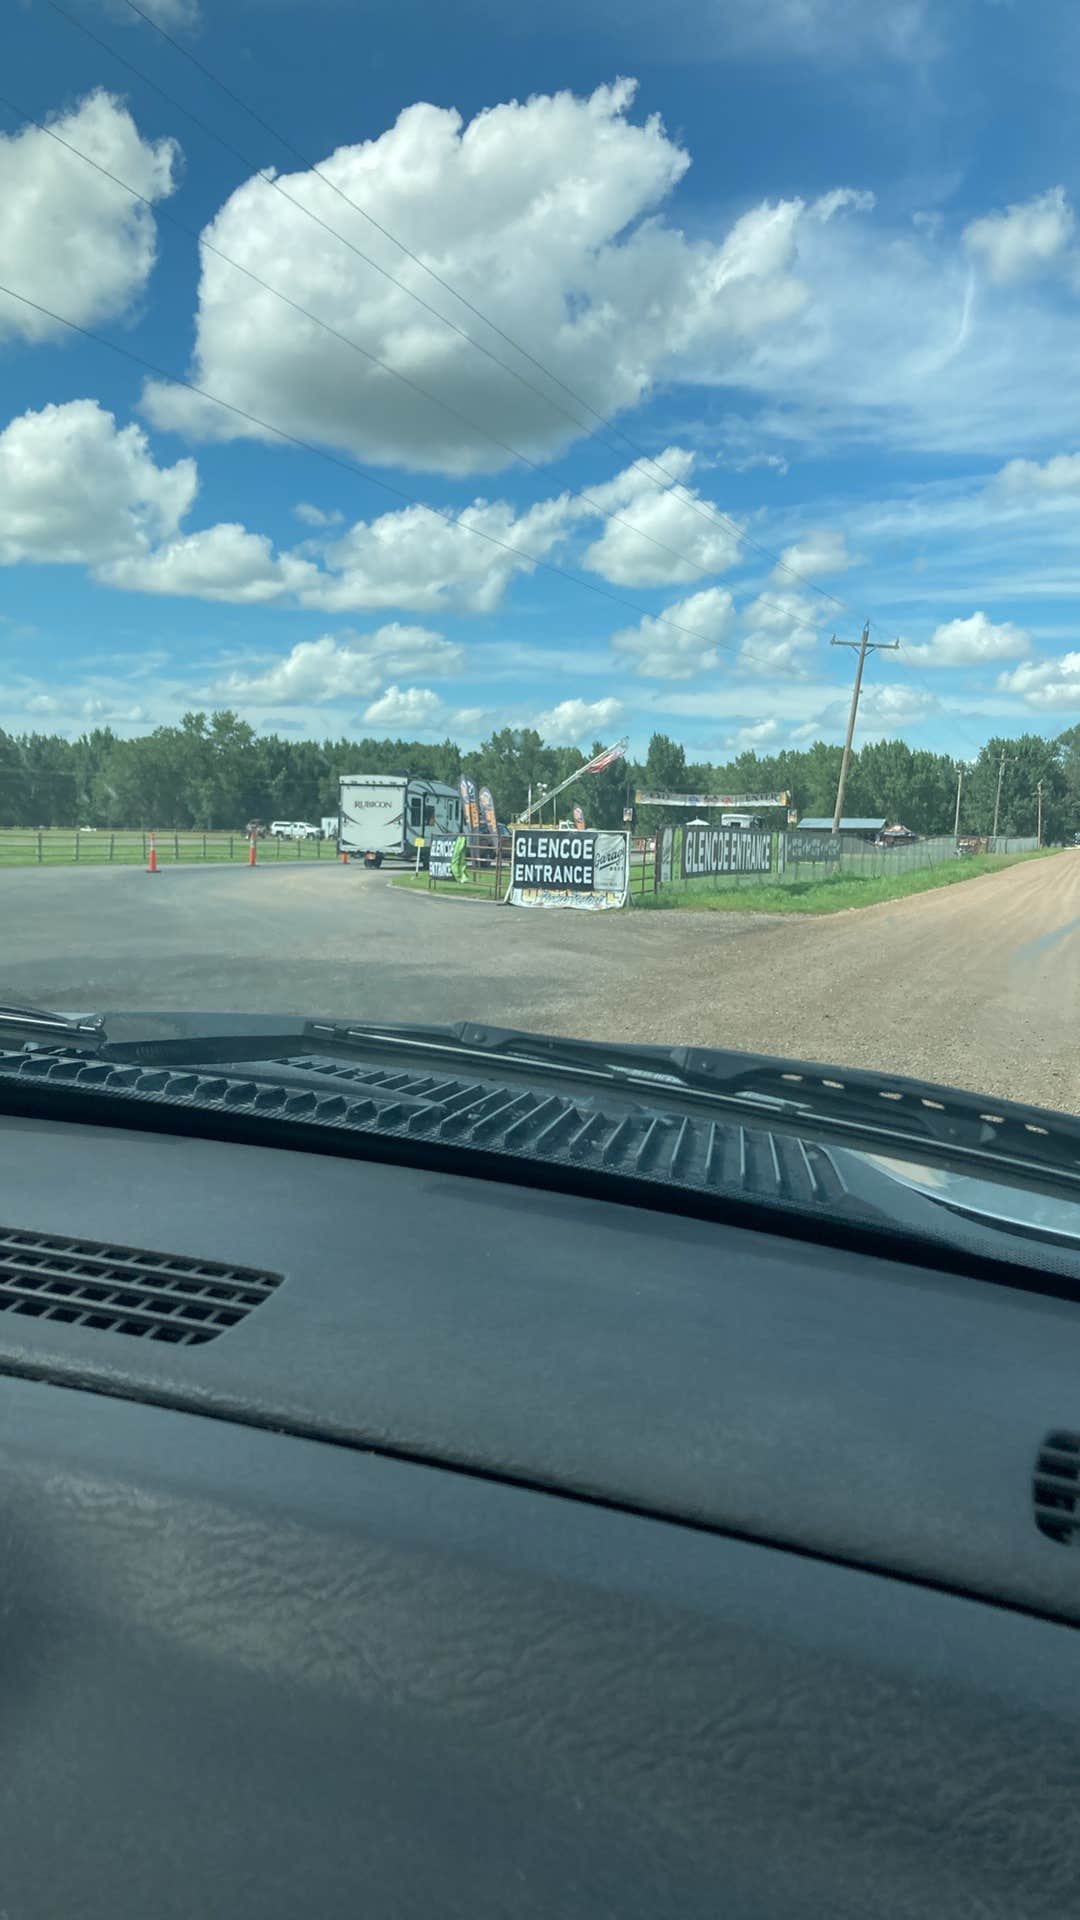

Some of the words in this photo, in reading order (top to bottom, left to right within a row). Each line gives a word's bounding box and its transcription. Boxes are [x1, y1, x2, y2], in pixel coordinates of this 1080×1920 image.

[354, 800, 392, 809] RUBICON
[515, 837, 594, 860] GLENCOE
[685, 831, 730, 873] GLENCOE
[730, 833, 770, 872] ENTRANCE
[515, 864, 593, 884] ENTRANCE
